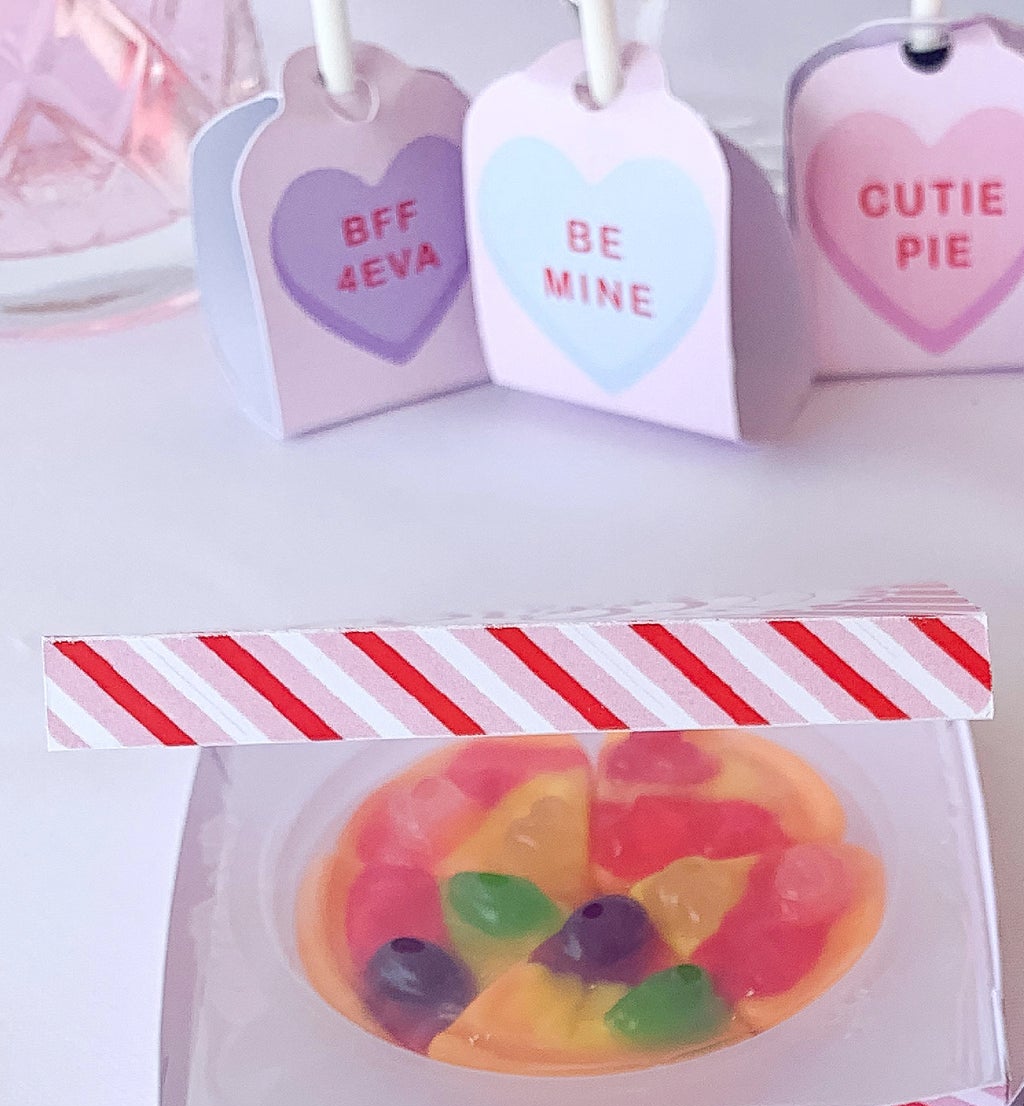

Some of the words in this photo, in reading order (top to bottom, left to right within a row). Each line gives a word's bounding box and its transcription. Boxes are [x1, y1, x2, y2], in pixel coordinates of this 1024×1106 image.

[858, 180, 1006, 219] CUTIE
[341, 200, 418, 248] BFF
[567, 219, 625, 260] BE
[337, 241, 441, 293] 4EVA
[895, 233, 974, 270] PIE
[543, 266, 655, 318] MINE
